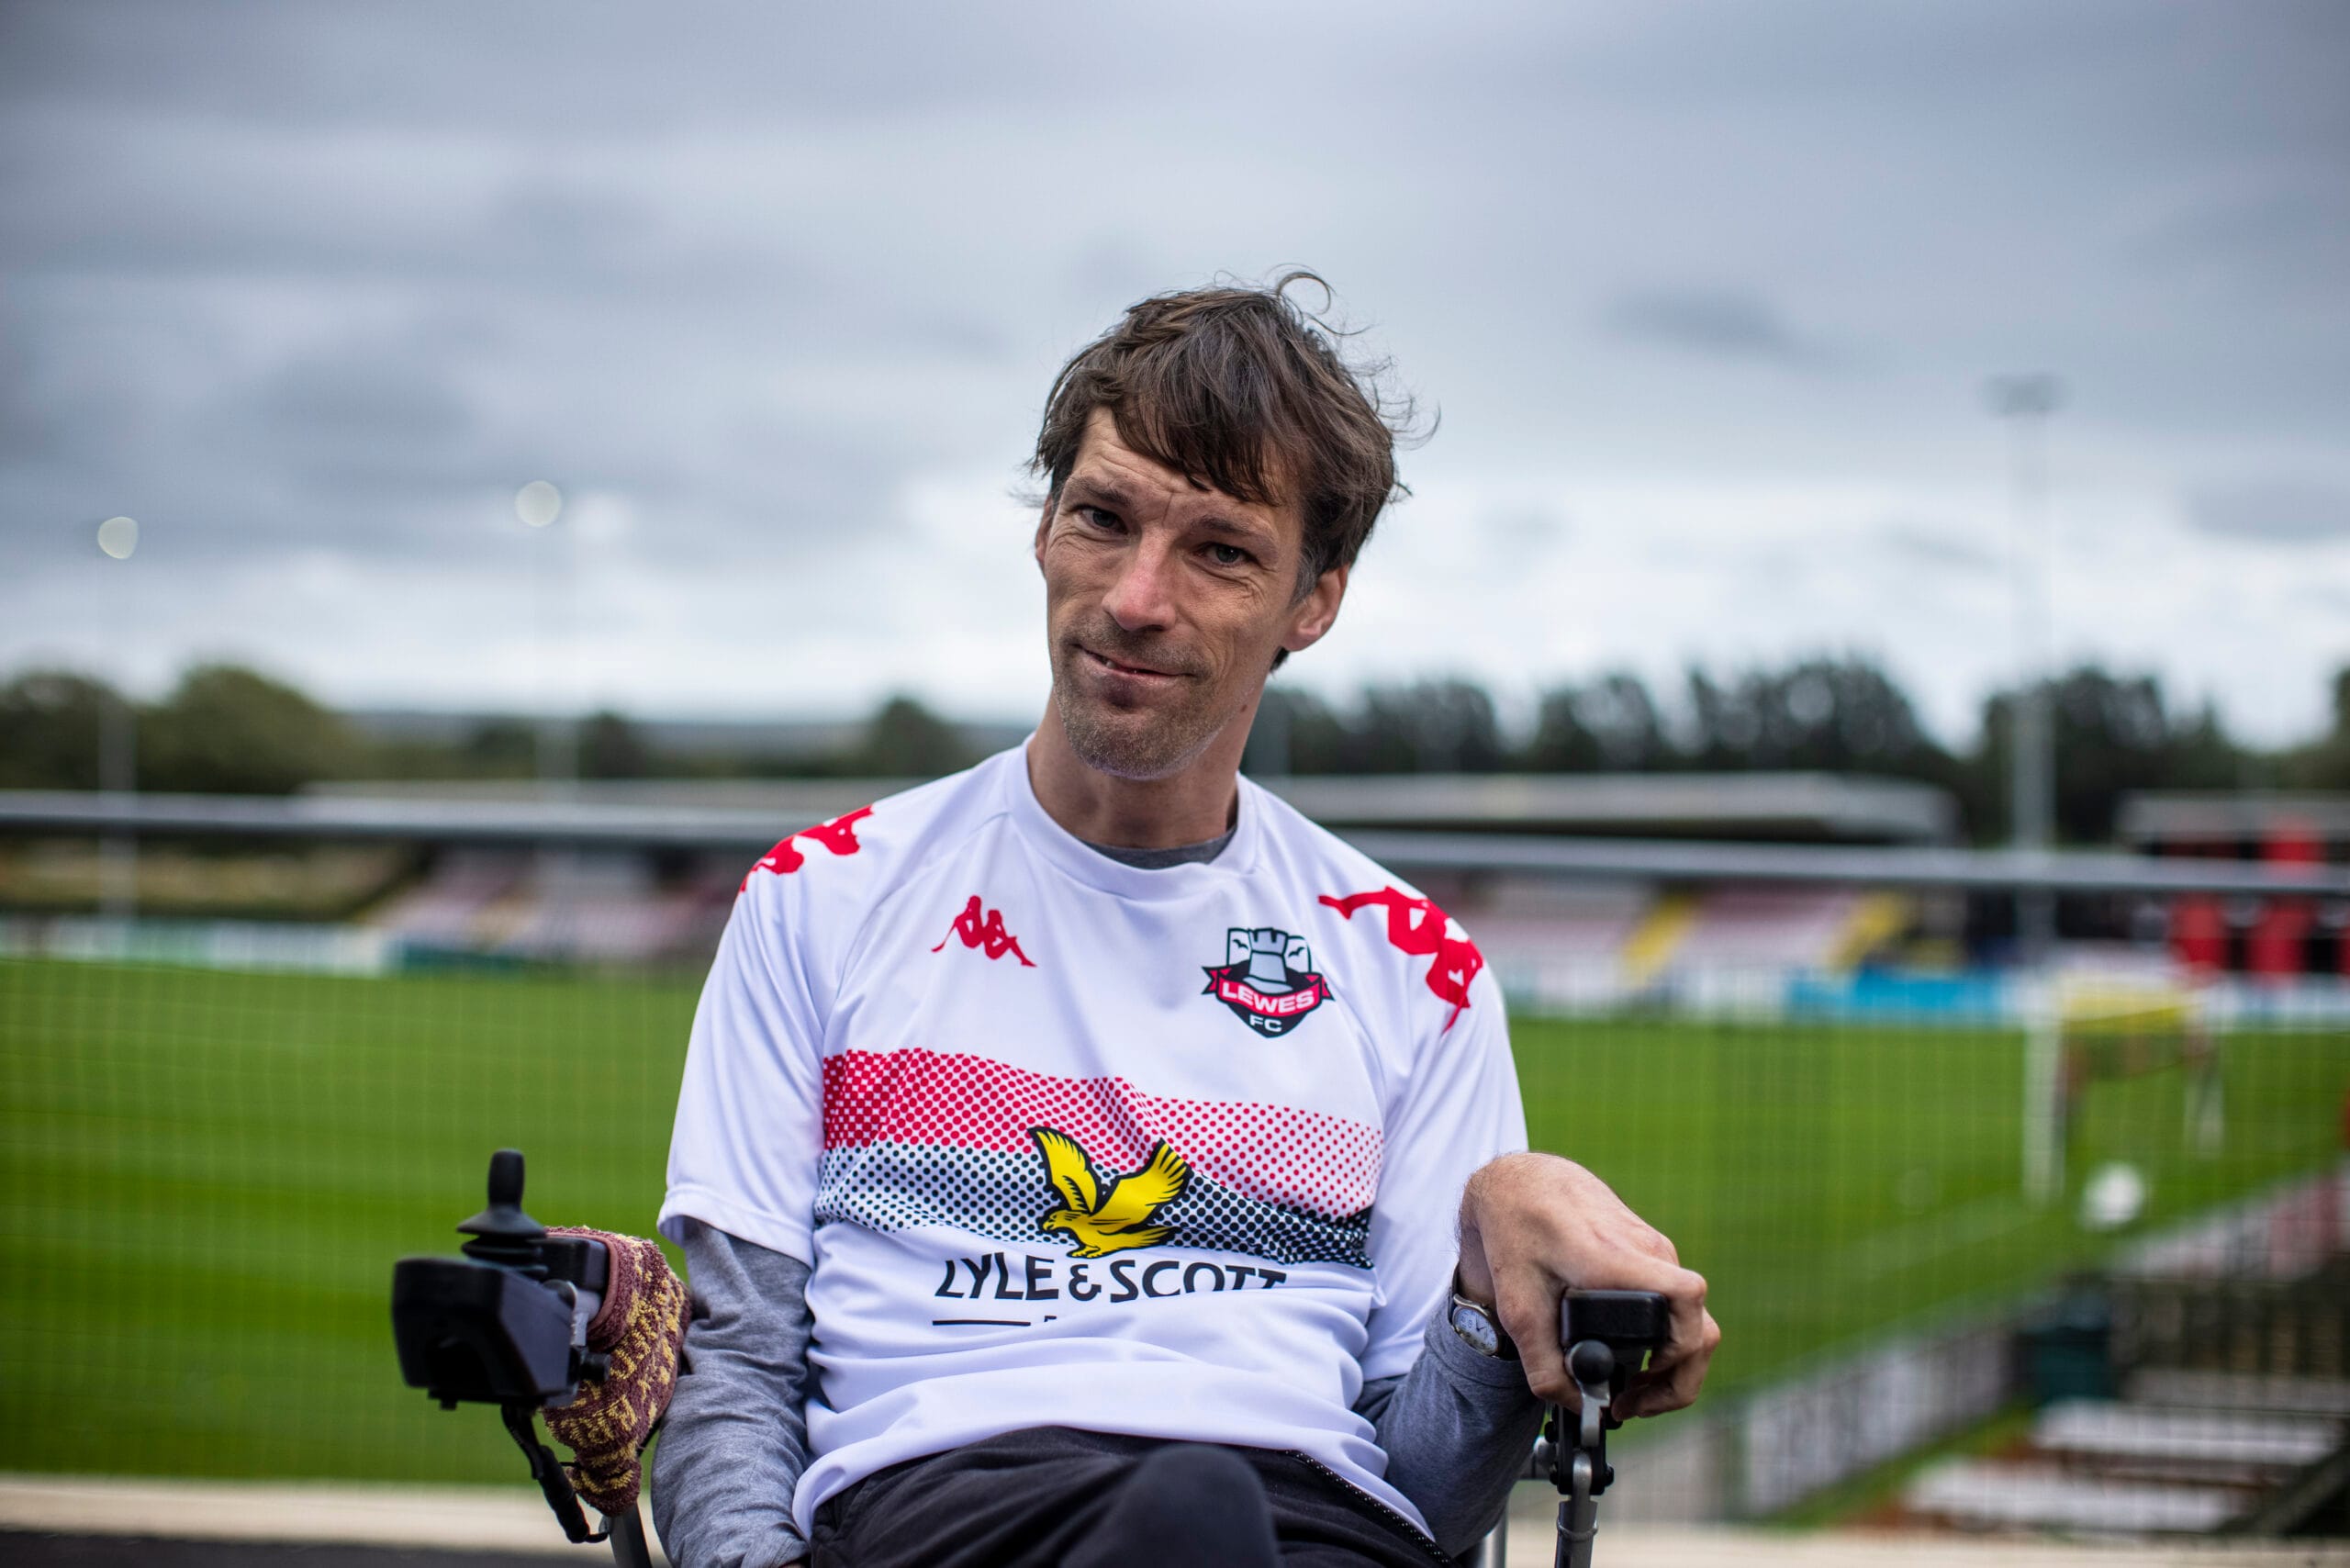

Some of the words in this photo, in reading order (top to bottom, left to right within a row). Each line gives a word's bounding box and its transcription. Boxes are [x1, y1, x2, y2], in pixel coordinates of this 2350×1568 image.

[1222, 981, 1315, 1014] LEWES
[1249, 1014, 1282, 1033] FC
[934, 1251, 1059, 1301] LYLE
[1069, 1263, 1102, 1302] &
